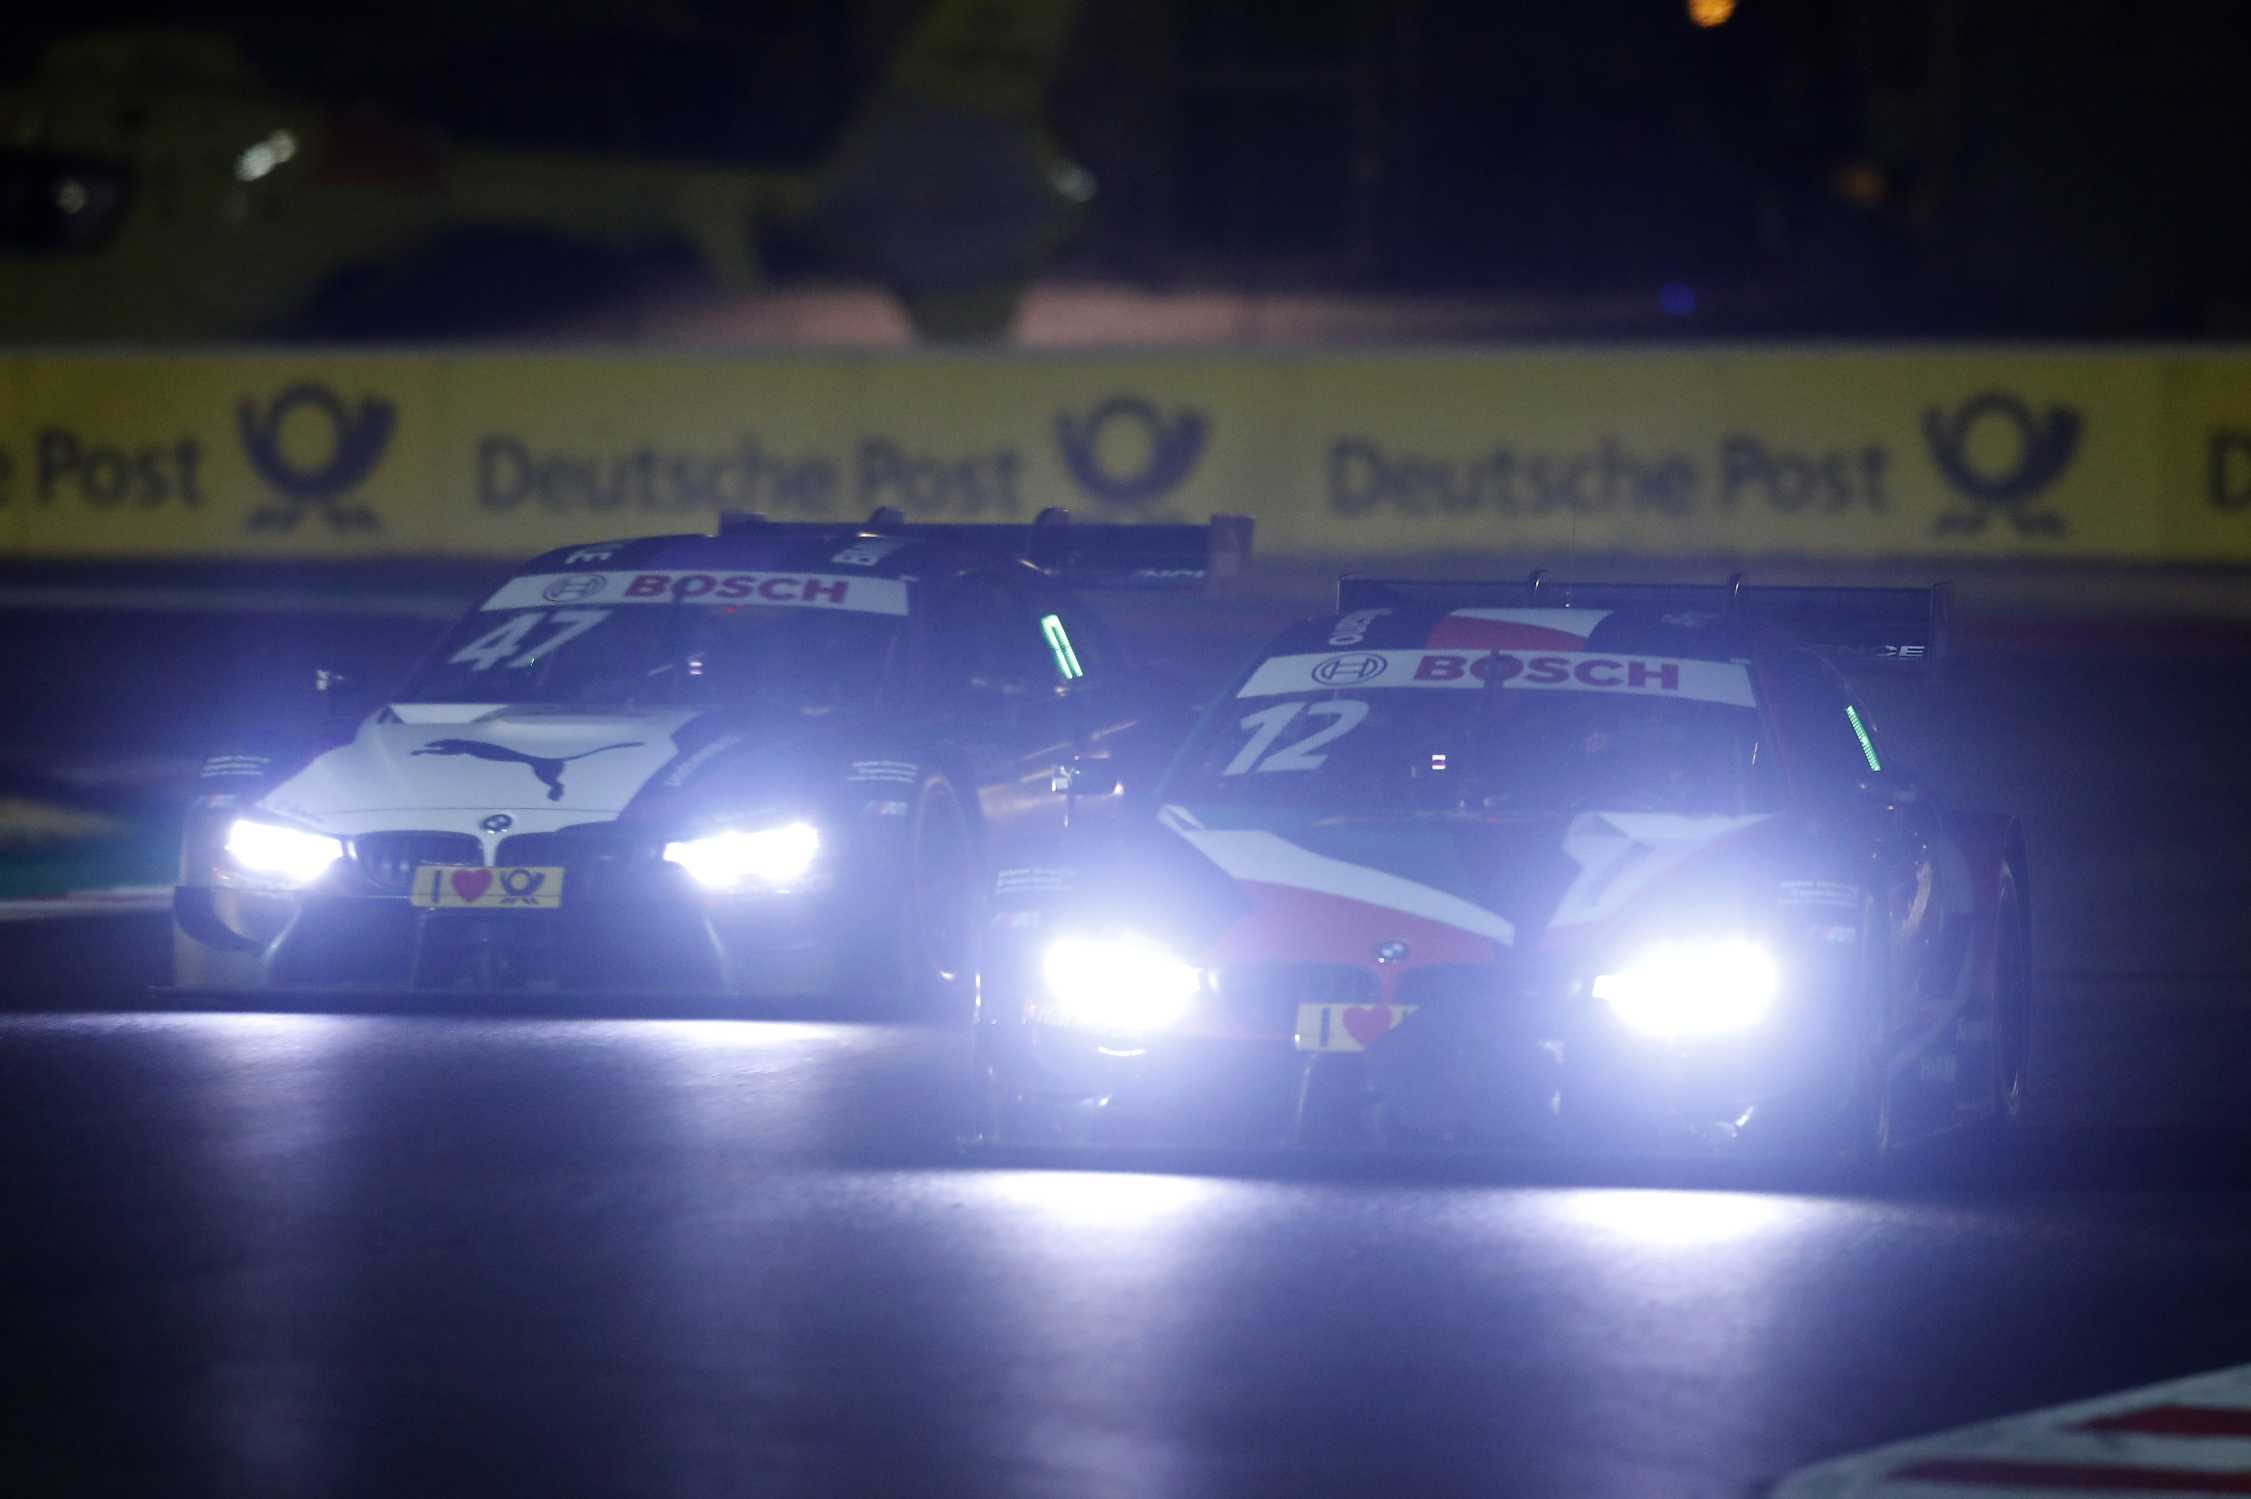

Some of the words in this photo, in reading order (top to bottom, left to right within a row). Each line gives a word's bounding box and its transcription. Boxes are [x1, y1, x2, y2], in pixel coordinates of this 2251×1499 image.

[36, 428, 206, 505] Post
[475, 432, 840, 506] Deutsche
[855, 438, 1020, 508] Post
[1328, 436, 1700, 514] Deutsche
[1720, 434, 1890, 512] Post
[624, 575, 848, 604] BOSCH
[448, 610, 612, 672] 47
[1414, 655, 1679, 690] BOSCH
[1222, 699, 1369, 776] 12
